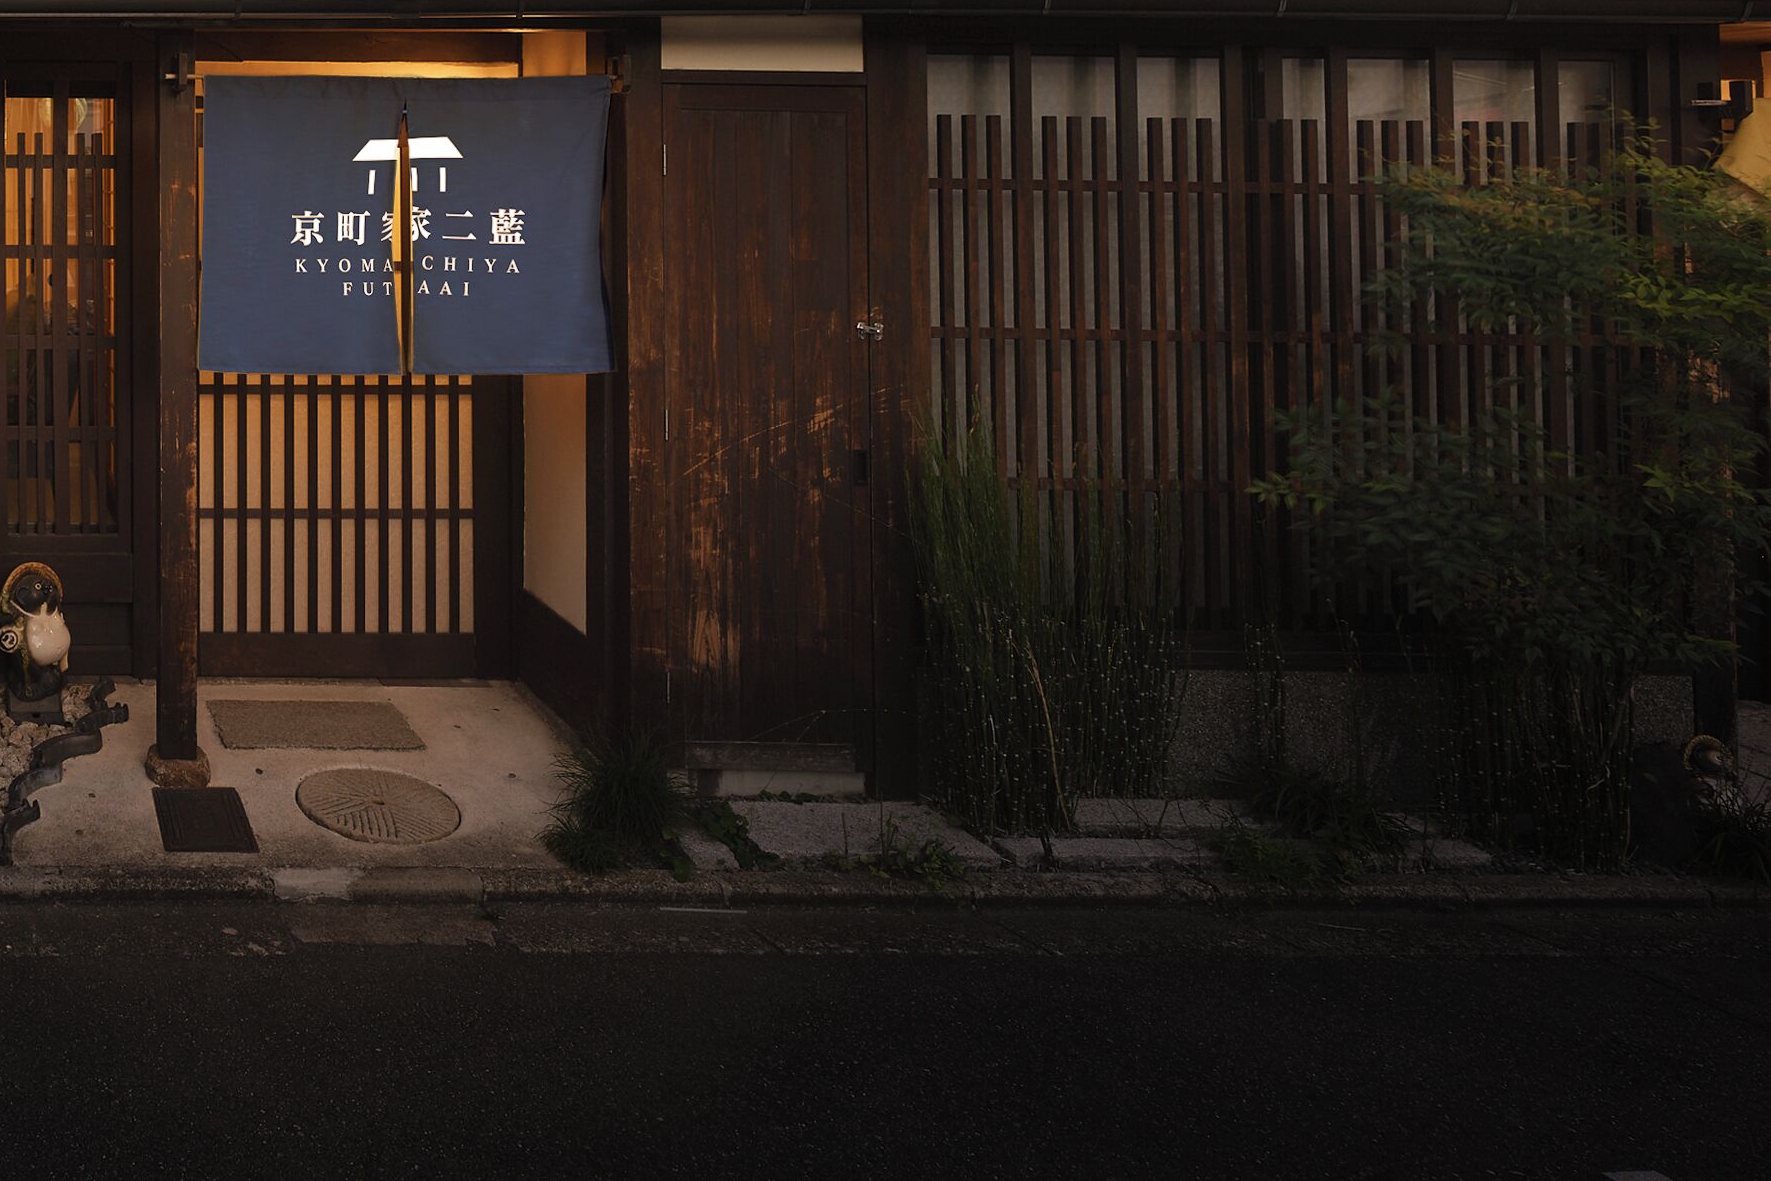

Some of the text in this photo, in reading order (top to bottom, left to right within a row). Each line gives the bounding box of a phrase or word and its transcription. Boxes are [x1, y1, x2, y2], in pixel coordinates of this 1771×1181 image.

[290, 207, 526, 246] 京町家二藍
[295, 255, 520, 274] KYOMACHIYA
[343, 280, 470, 297] FUTAAI
